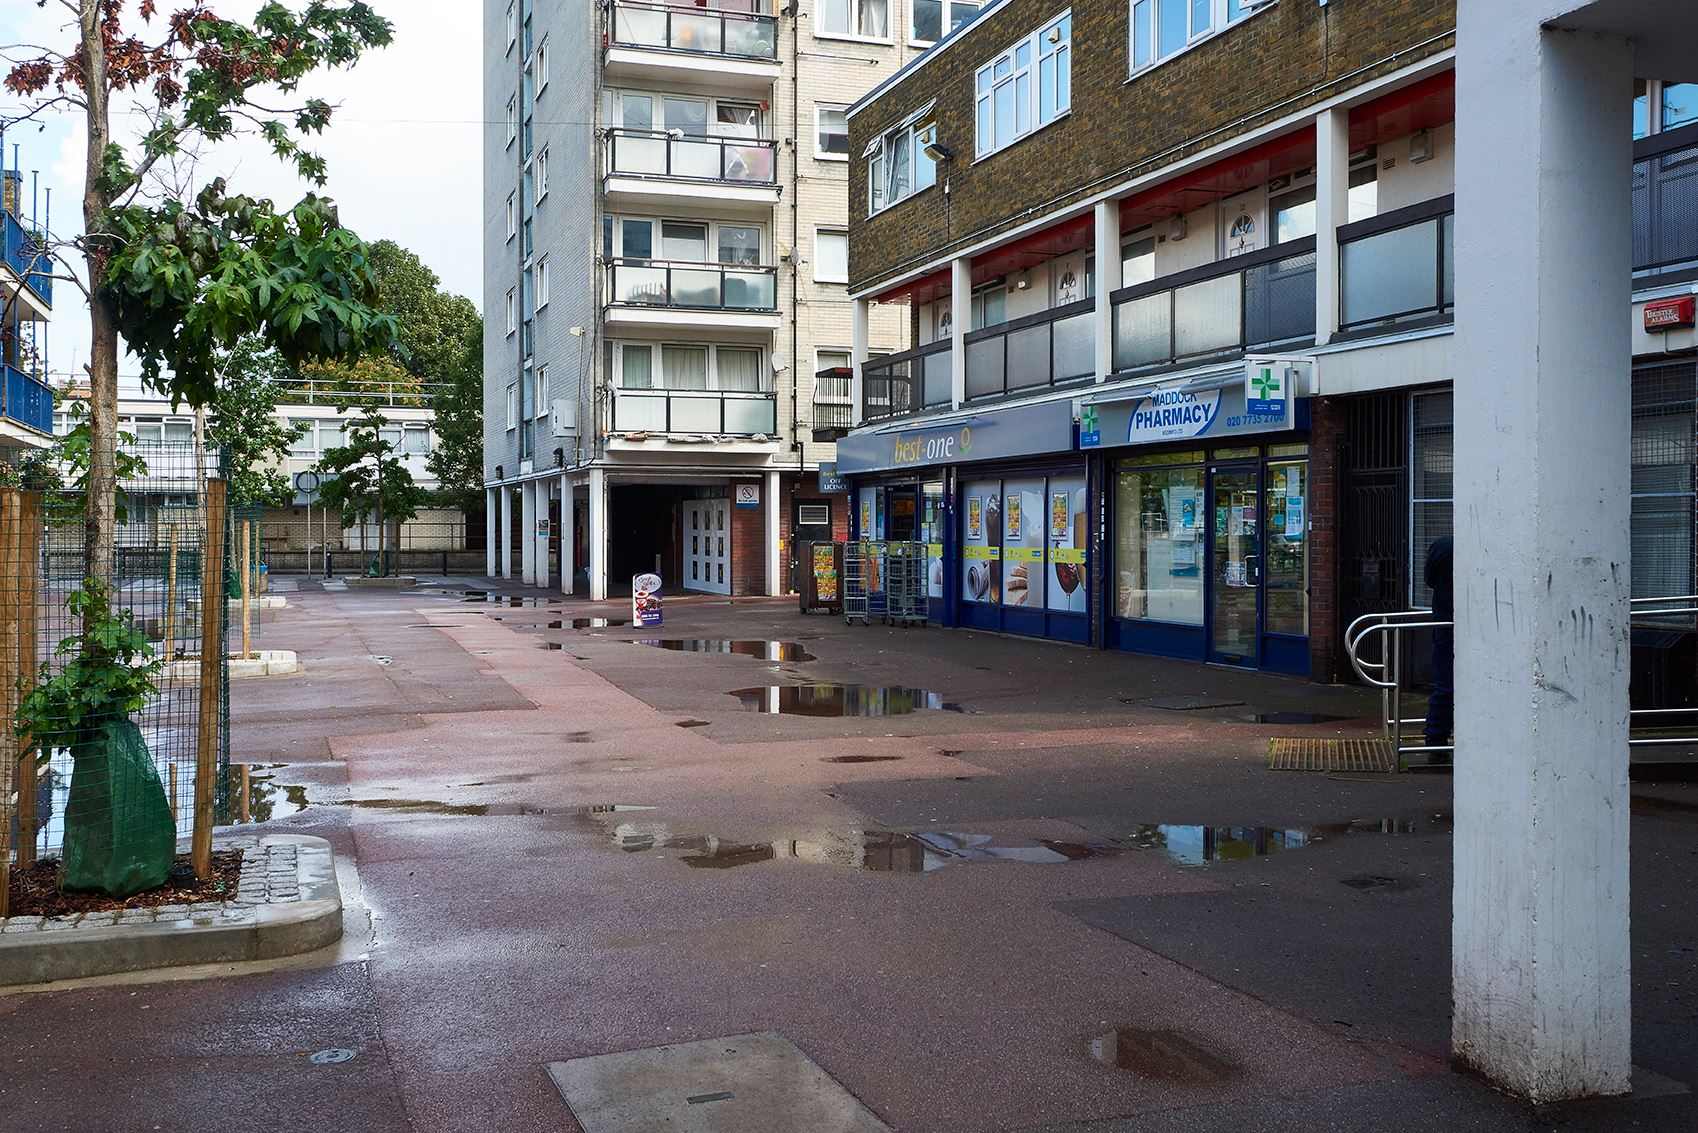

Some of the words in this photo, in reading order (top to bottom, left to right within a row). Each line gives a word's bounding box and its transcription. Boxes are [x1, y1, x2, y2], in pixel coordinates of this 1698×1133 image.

[1136, 403, 1211, 429] PHARMACY
[1227, 416, 1241, 427] 020
[1243, 415, 1262, 425] 7735
[895, 436, 954, 463] best-one
